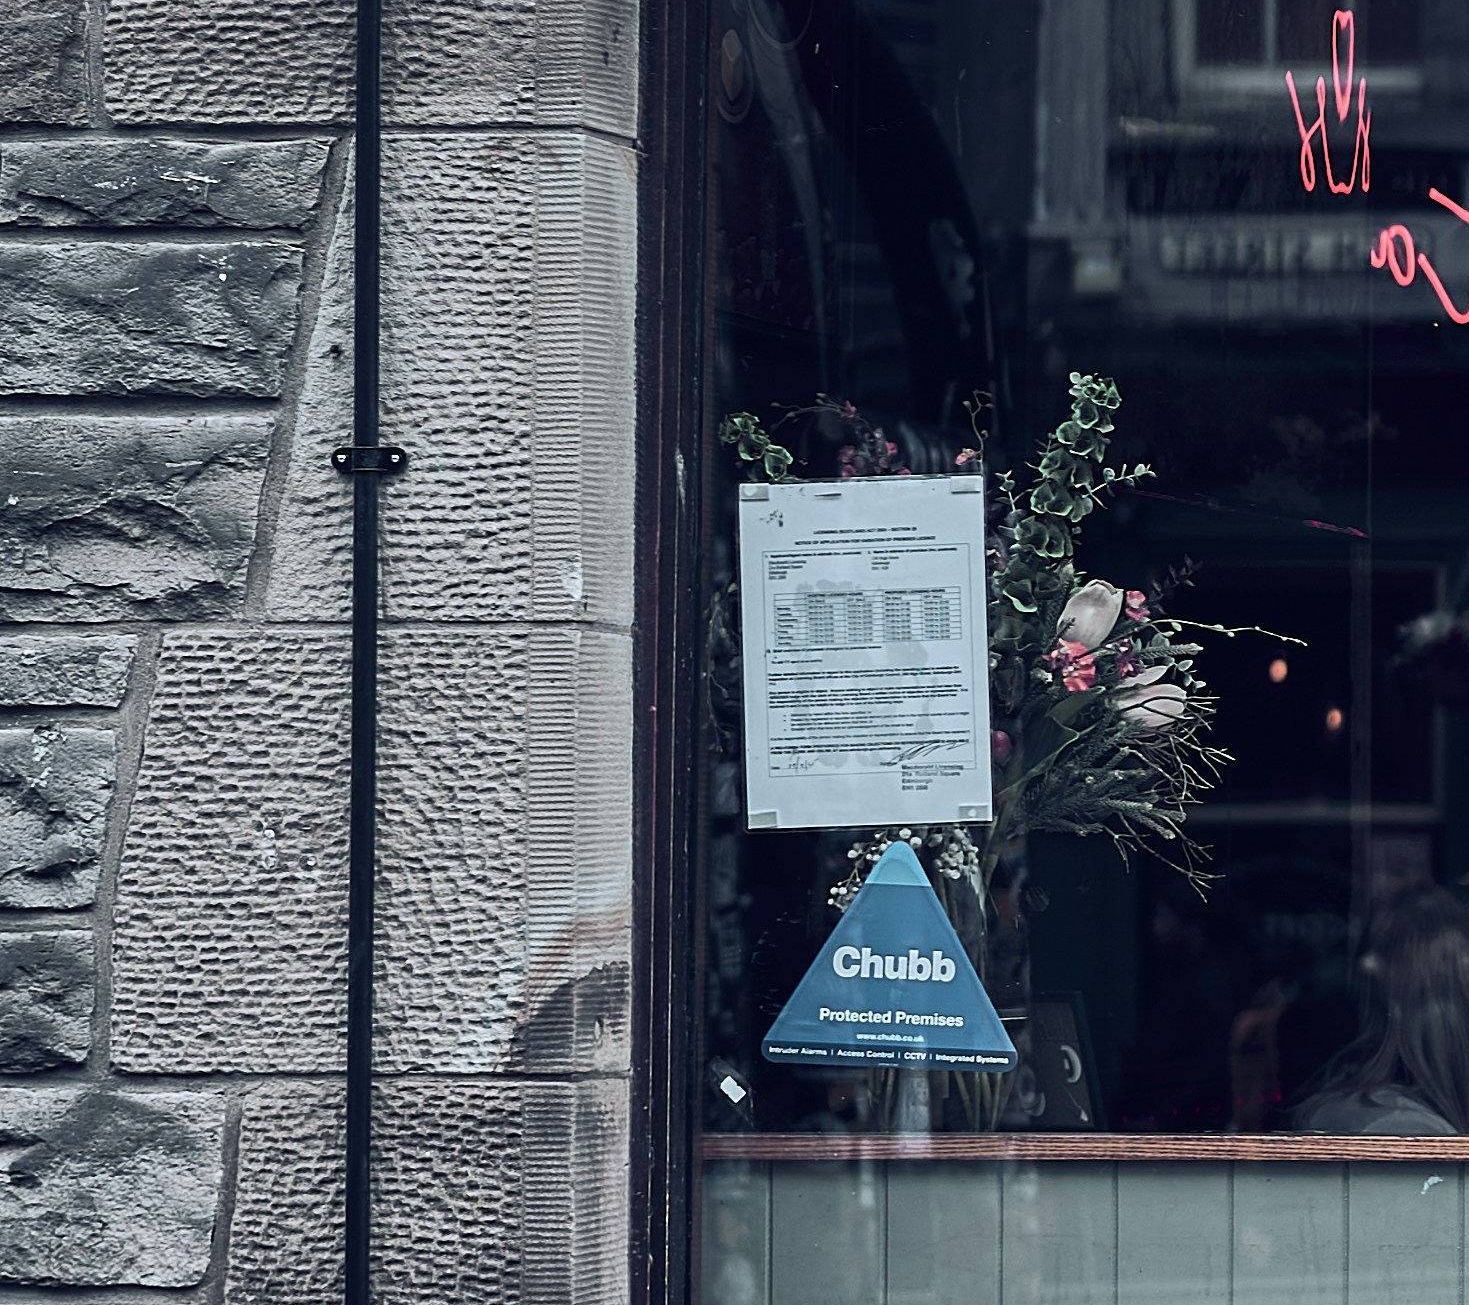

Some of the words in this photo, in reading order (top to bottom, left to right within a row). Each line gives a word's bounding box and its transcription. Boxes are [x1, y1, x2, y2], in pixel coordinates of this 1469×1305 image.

[833, 946, 955, 982] Chubb
[820, 1008, 891, 1024] Protected
[895, 1011, 964, 1027] Premises
[838, 1049, 864, 1057] Access
[867, 1050, 894, 1058] Control
[904, 1052, 926, 1060] CCTV
[936, 1054, 974, 1063] Integrated
[977, 1056, 1009, 1064] Systems
